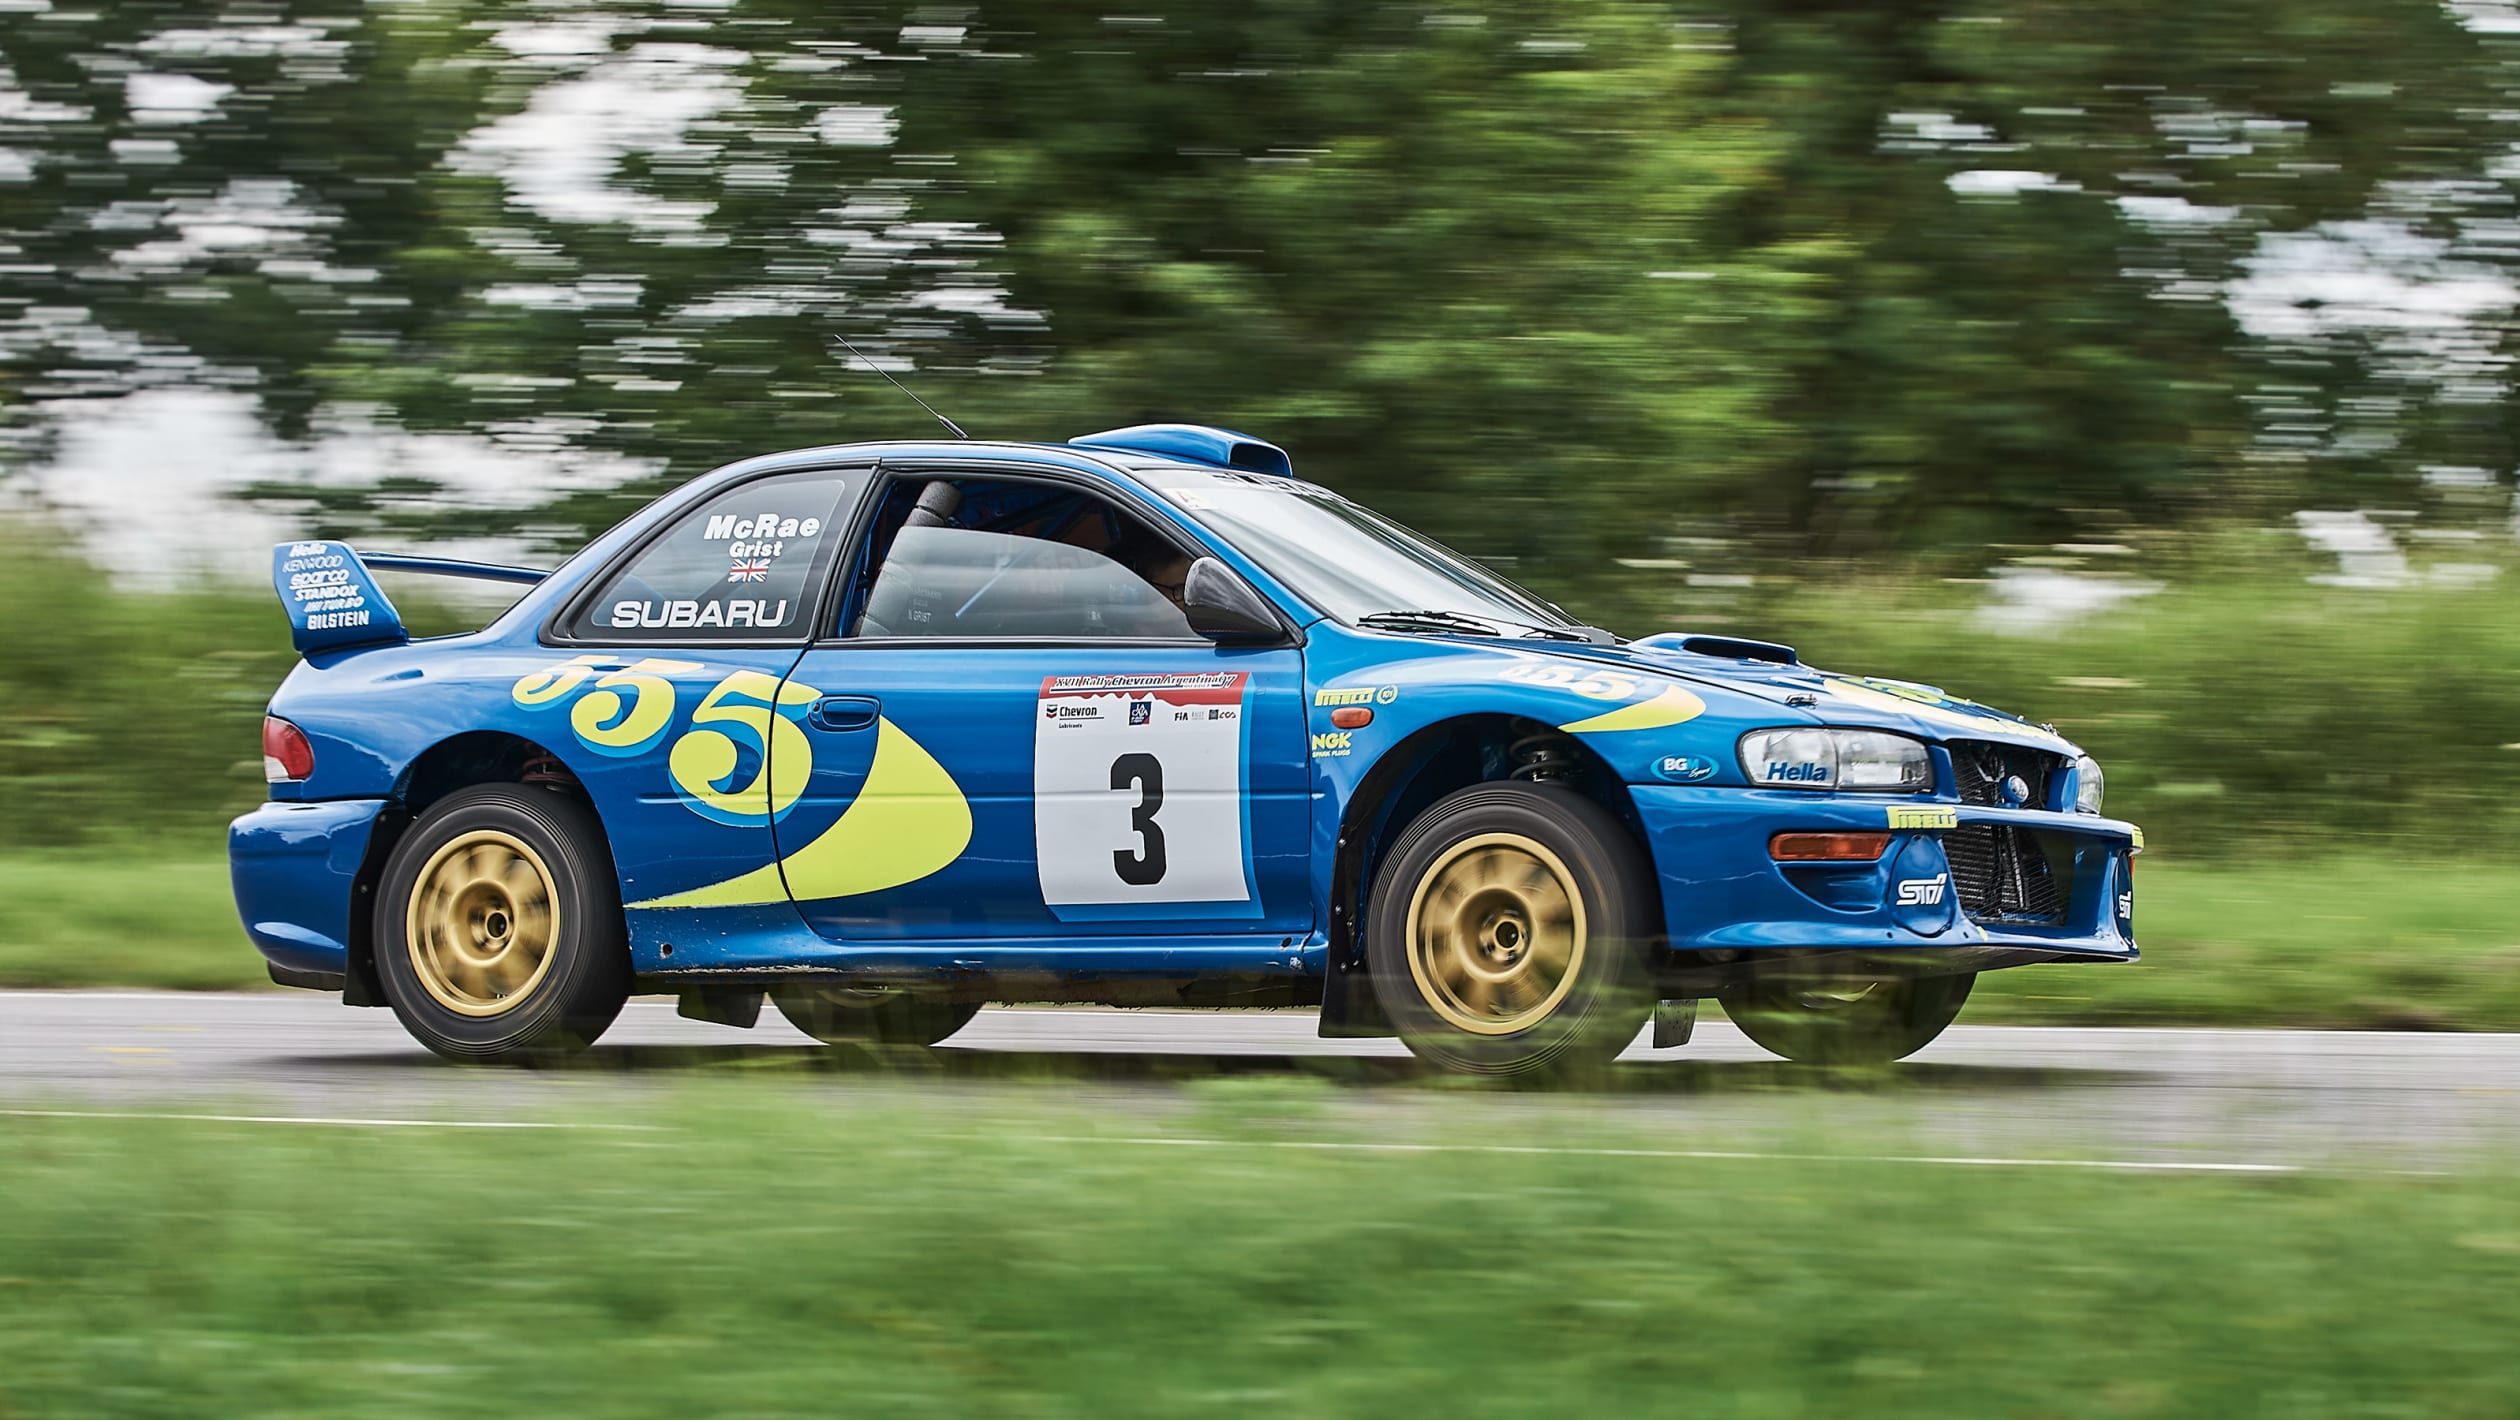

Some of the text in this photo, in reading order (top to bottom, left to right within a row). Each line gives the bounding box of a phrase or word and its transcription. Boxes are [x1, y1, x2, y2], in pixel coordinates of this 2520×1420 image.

[703, 512, 820, 540] McRae
[729, 541, 783, 558] Grist
[282, 555, 343, 573] KENWOOD
[294, 585, 360, 602] STANDOX
[307, 610, 370, 630] BILSTEIN
[611, 600, 787, 628] SUBARU
[1111, 674, 1161, 687] Chevron
[1315, 687, 1376, 706] PIRELLI
[1059, 706, 1098, 717] Chevron
[1312, 732, 1352, 751] NGK
[1767, 762, 1828, 782] Hella
[1110, 752, 1168, 886] 3
[1886, 805, 1958, 830] PIRELLI
